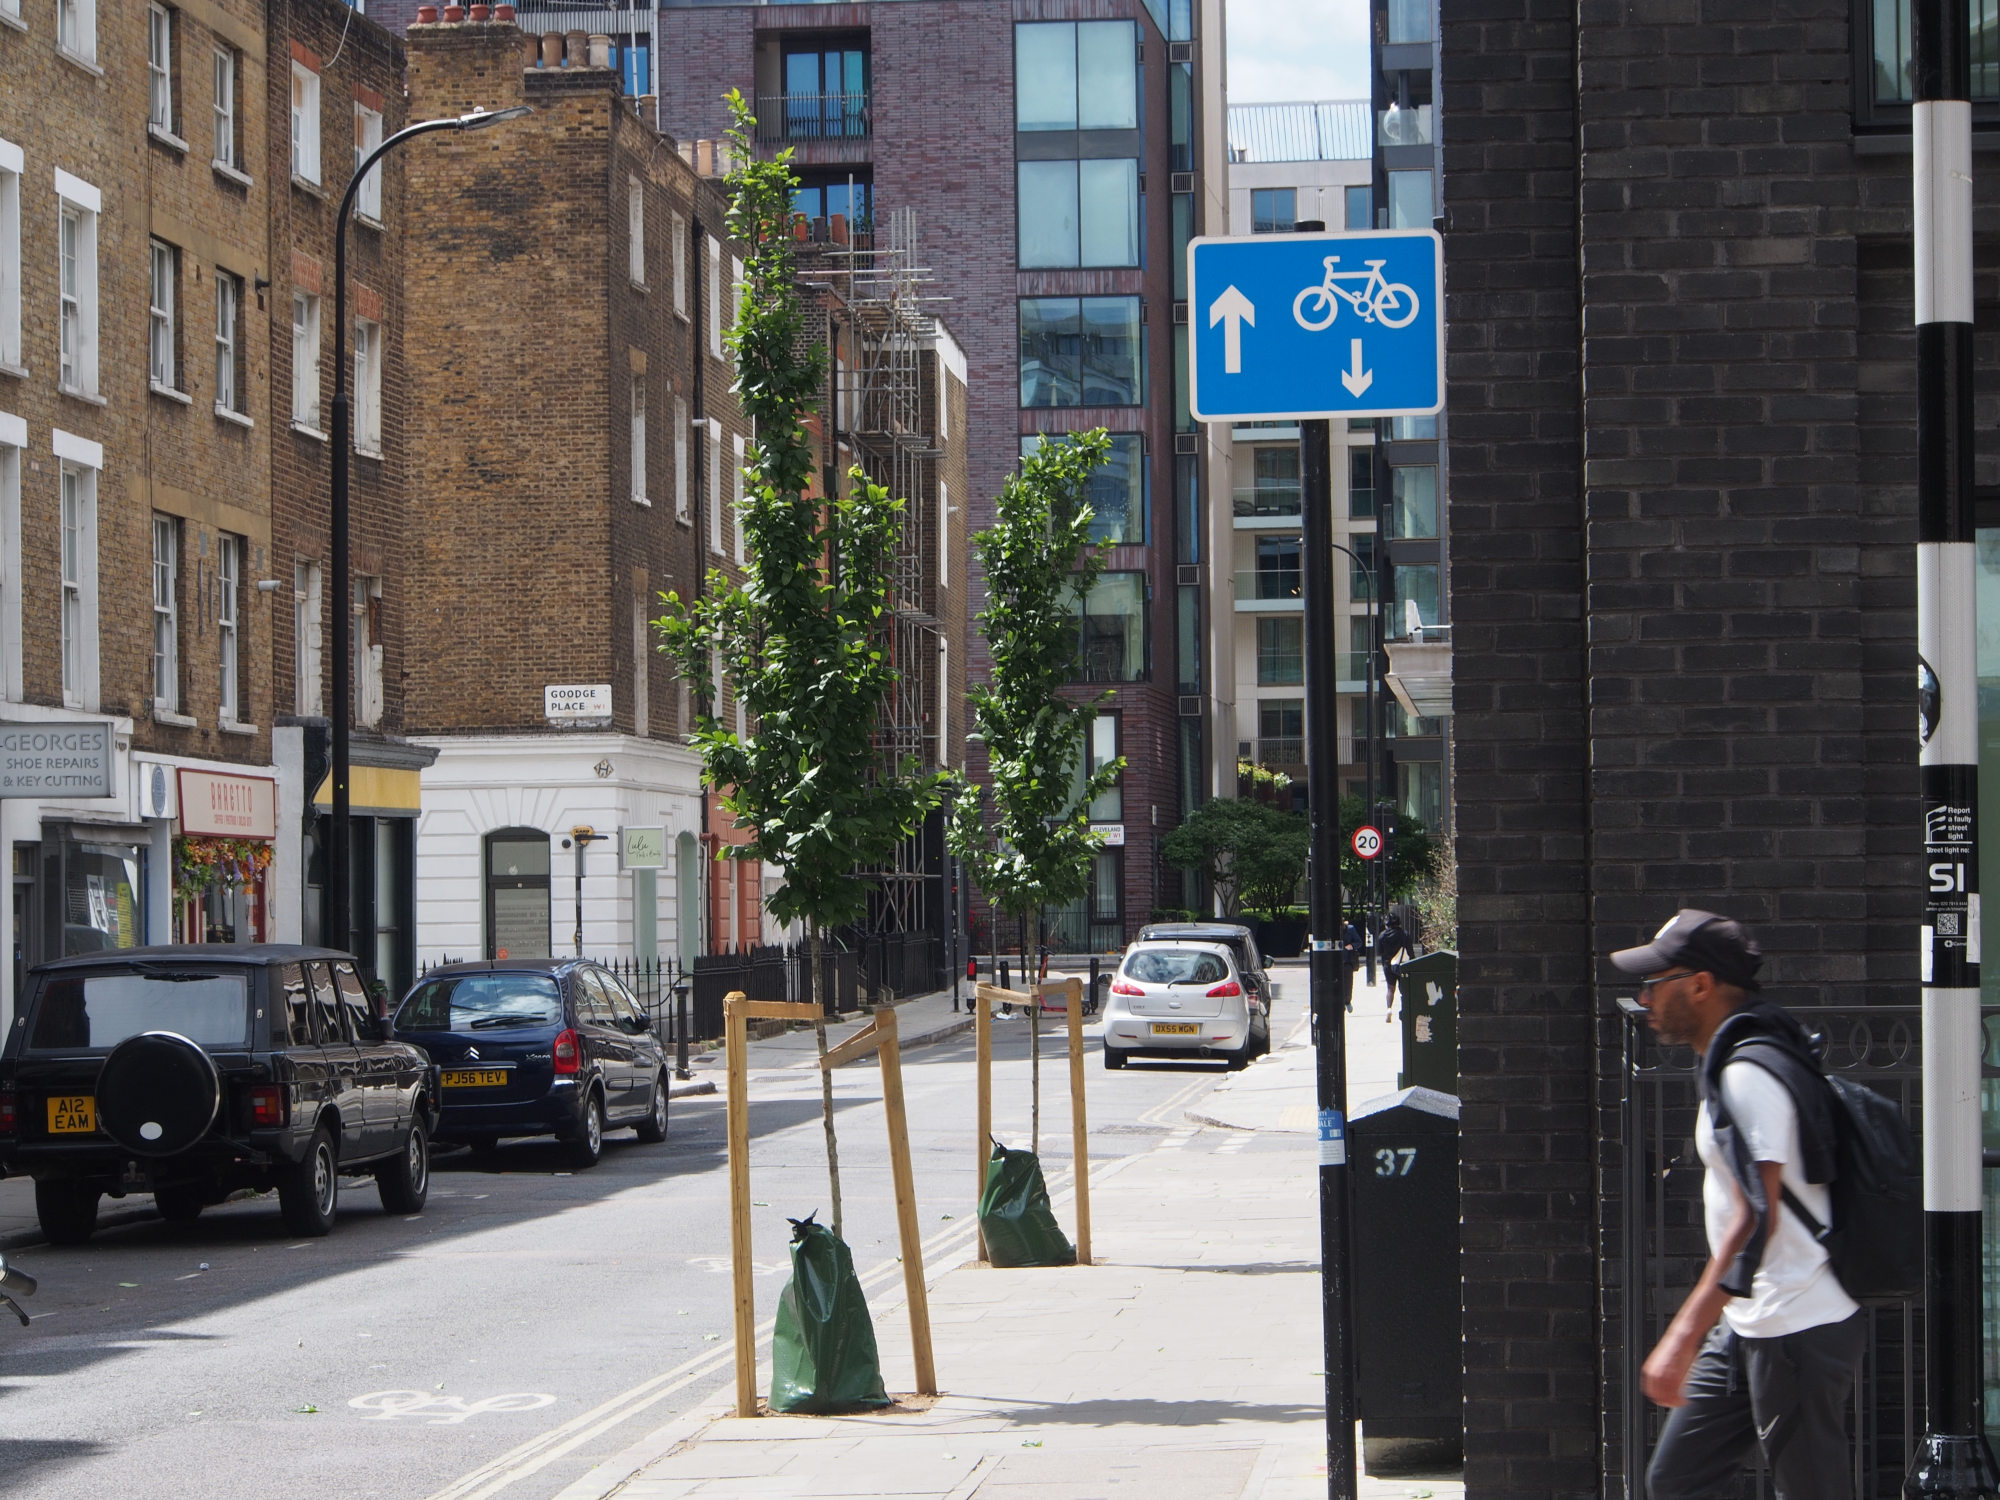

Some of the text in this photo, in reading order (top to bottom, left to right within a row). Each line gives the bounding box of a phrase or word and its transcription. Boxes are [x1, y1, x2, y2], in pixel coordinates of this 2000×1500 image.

[551, 689, 596, 698] GOODGE
[551, 702, 585, 711] PLACE
[4, 734, 102, 751] GEORGES
[6, 758, 99, 769] SHOE REPAIRS
[3, 775, 102, 787] & KEY CUTTING
[210, 781, 253, 813] BARETTO
[1954, 815, 1972, 824] faulty
[1358, 836, 1378, 849] 20
[1947, 833, 1964, 841] light
[627, 834, 649, 855] Lulu
[1944, 846, 1960, 854] light
[445, 1071, 502, 1084] PJ56 TEV
[58, 1099, 85, 1113] A12
[55, 1114, 89, 1129] EAM
[1375, 1148, 1417, 1176] 37
